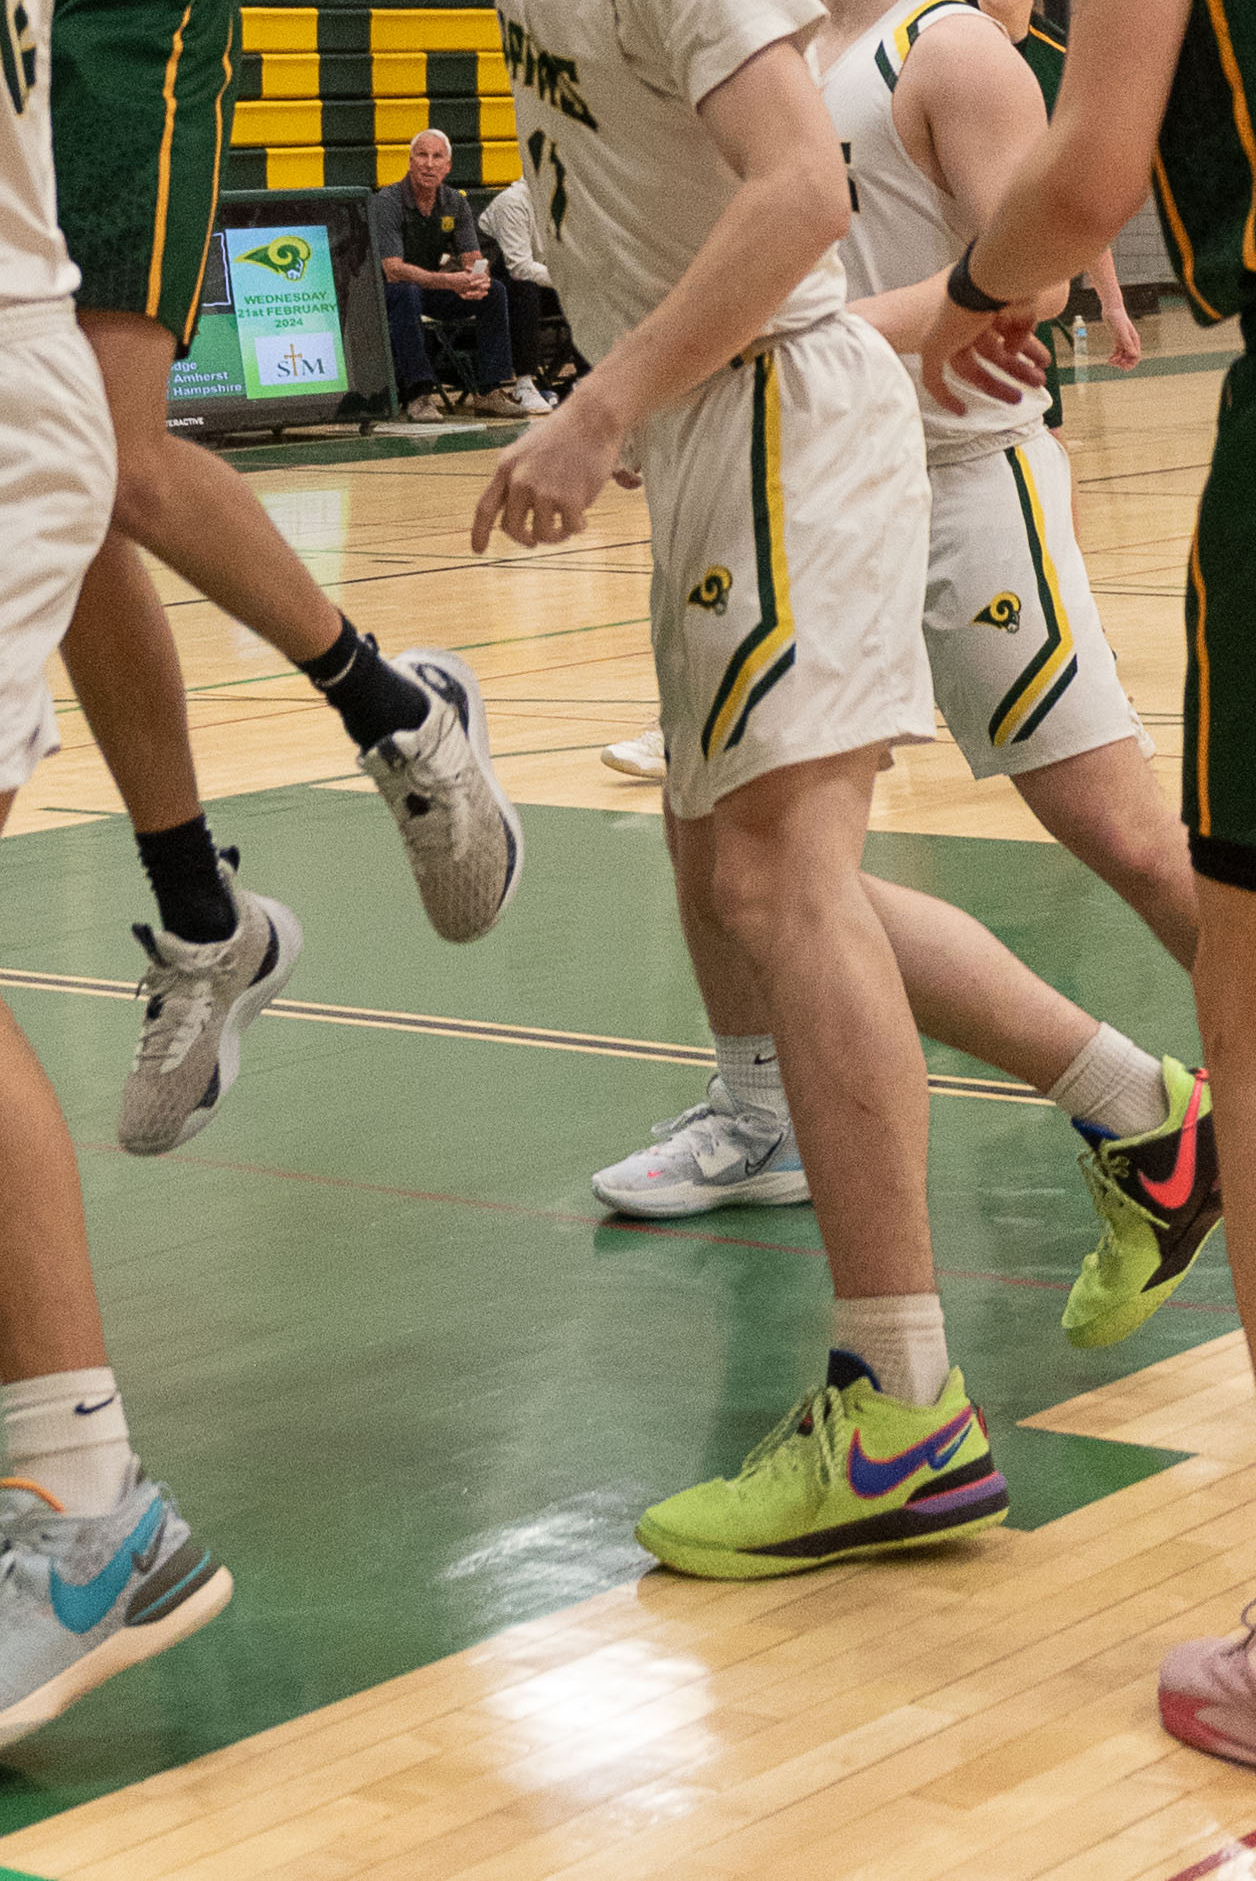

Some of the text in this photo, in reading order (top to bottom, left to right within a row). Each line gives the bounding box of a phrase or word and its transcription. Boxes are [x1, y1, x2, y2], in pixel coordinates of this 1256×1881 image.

[244, 291, 327, 305] WEDNESDAY
[237, 303, 337, 319] 21st FEBRUARY
[275, 317, 304, 329] 2024
[174, 371, 228, 384] Amherst
[172, 384, 242, 396] Hampshire
